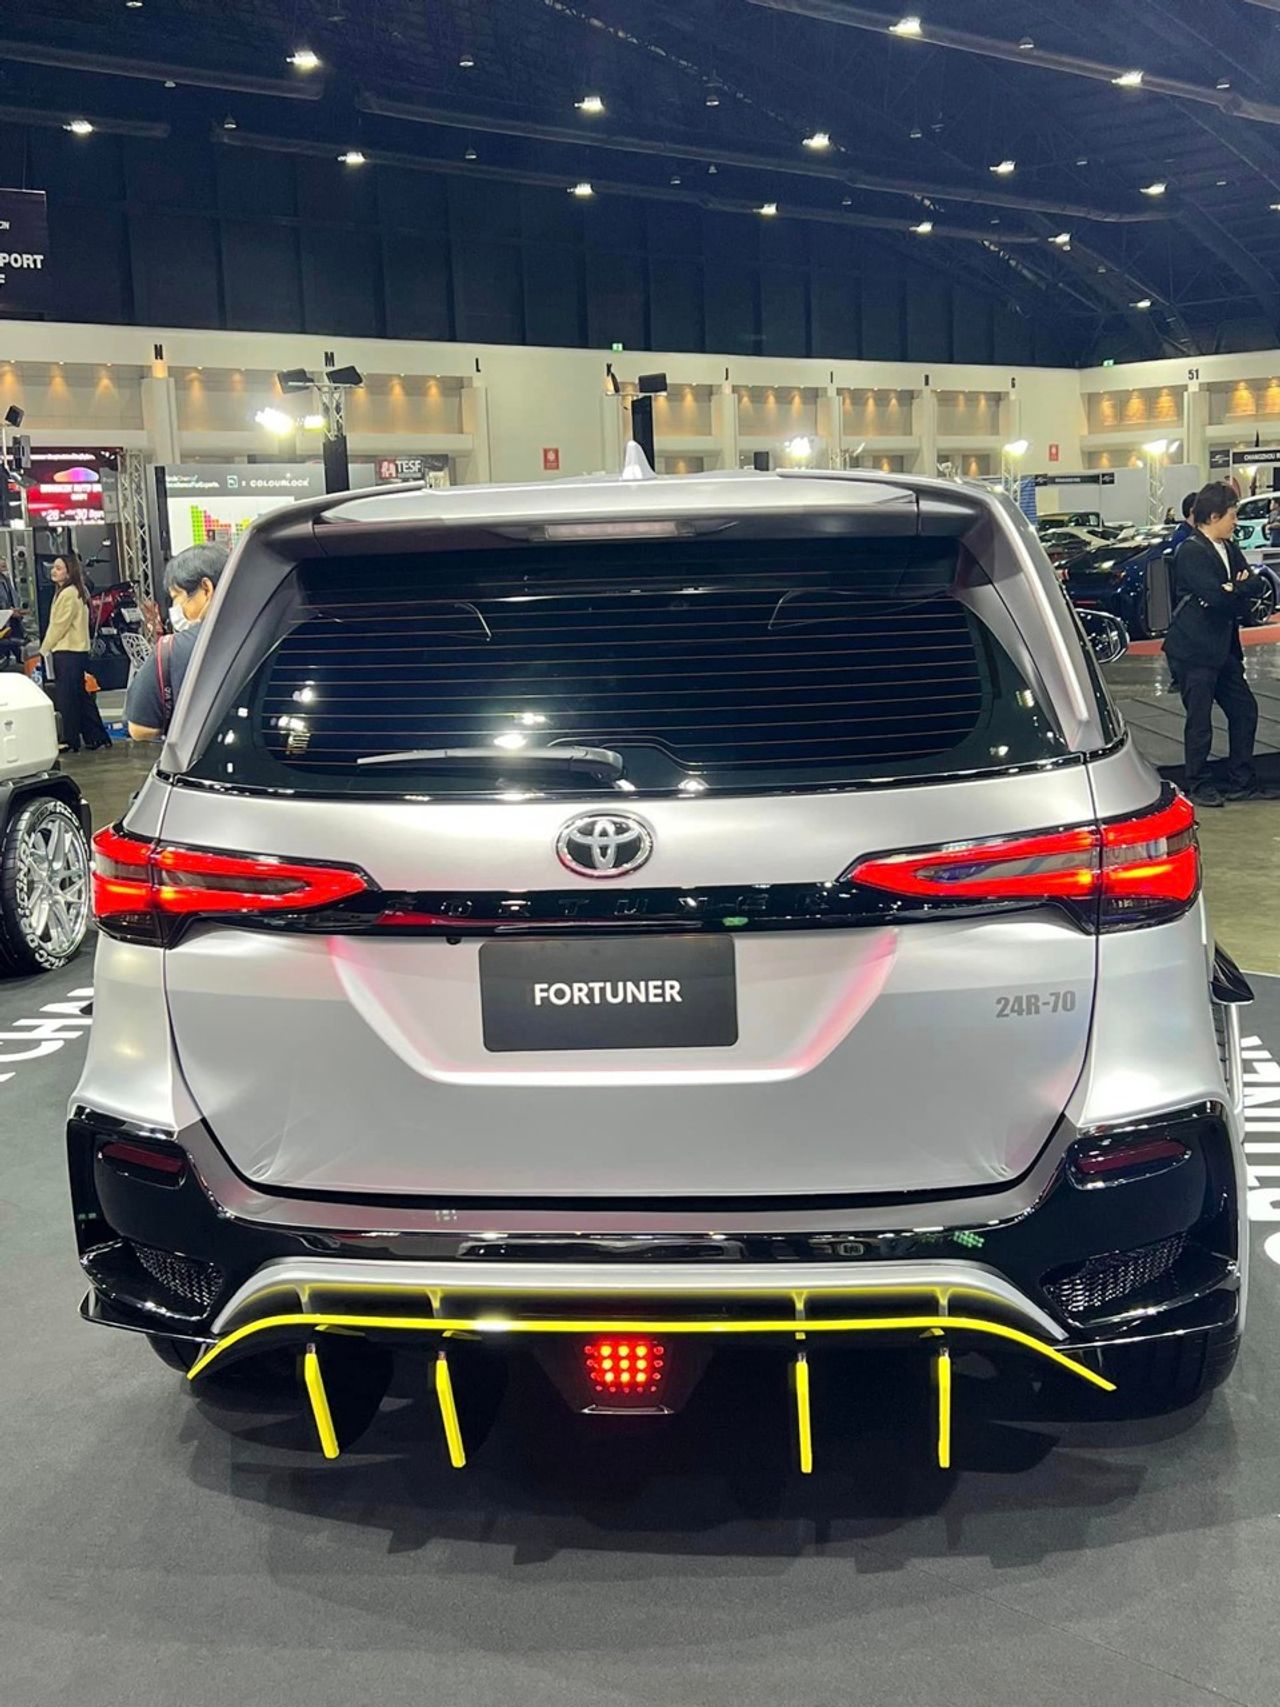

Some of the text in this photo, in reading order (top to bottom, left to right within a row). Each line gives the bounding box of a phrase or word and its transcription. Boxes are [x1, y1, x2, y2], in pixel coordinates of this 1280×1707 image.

[324, 352, 335, 367] M
[475, 358, 481, 372] L
[1188, 369, 1199, 380] 51
[534, 979, 683, 1006] FORTUNER
[995, 990, 1076, 1019] 24R-70
